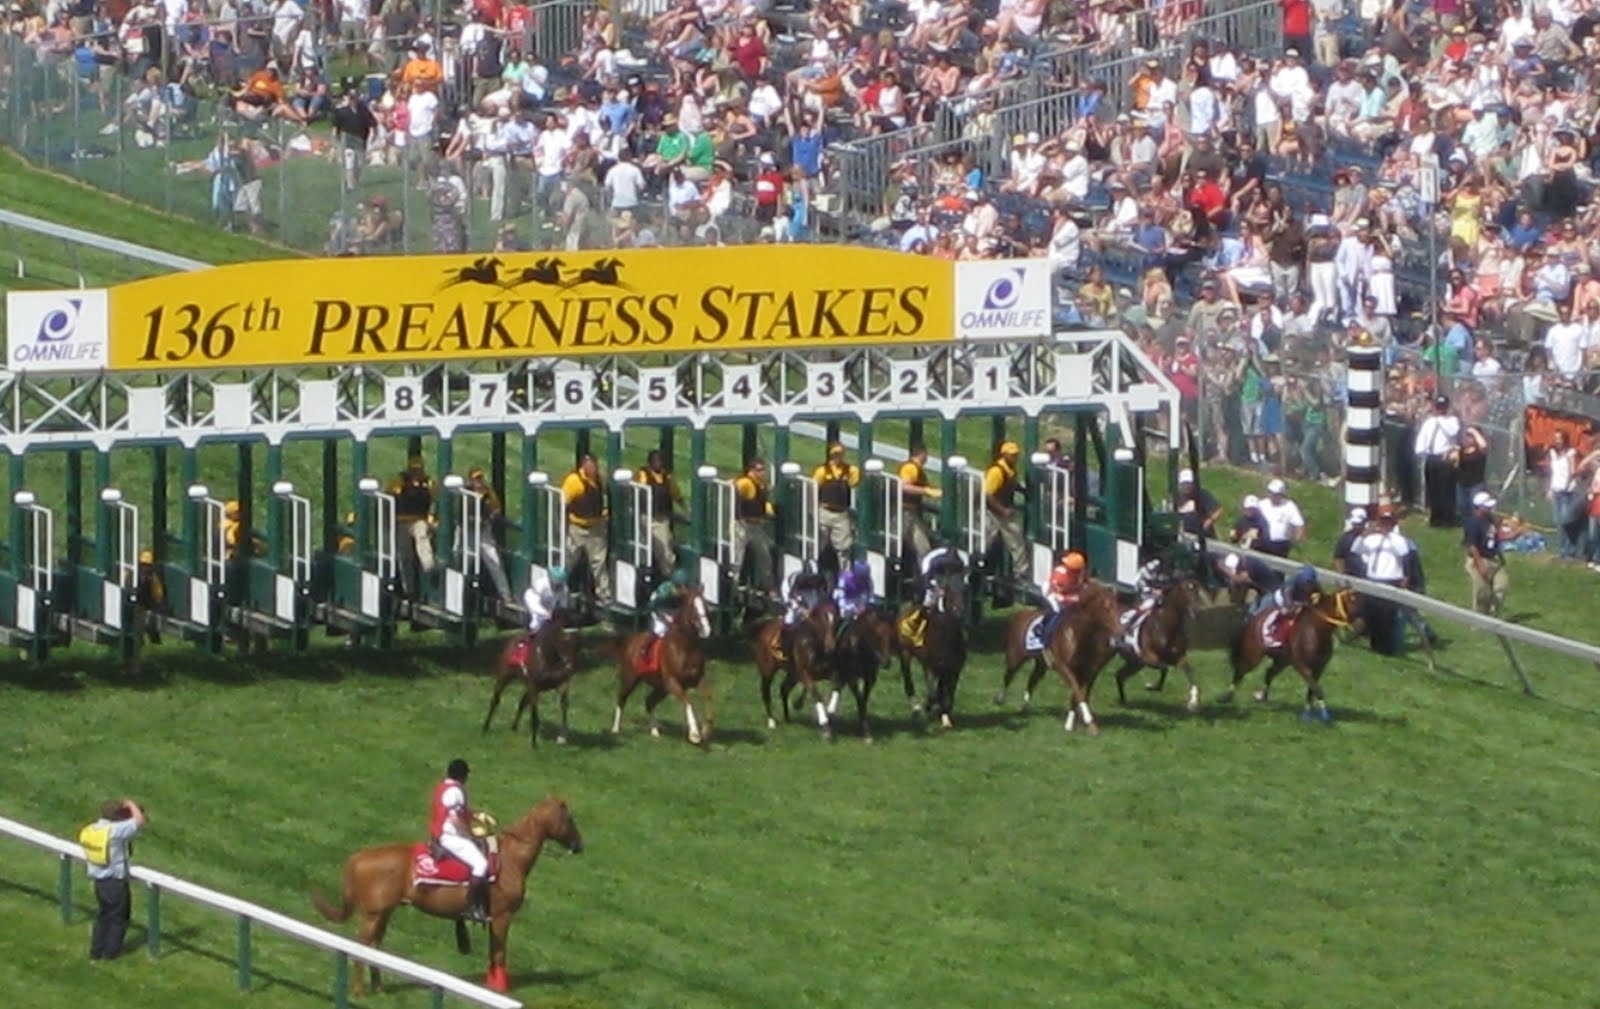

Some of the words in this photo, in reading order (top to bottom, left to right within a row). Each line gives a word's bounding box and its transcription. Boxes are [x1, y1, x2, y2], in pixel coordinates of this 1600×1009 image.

[137, 297, 282, 363] 136th
[304, 293, 680, 357] PREAKNESS
[692, 285, 930, 344] STAKES
[961, 309, 1047, 331] OMNILIFE
[13, 341, 102, 363] OMNILIFE
[648, 376, 667, 402] 5
[732, 374, 752, 399] 4
[816, 372, 836, 397] 3
[899, 369, 919, 394] 2
[984, 366, 999, 391] 1
[394, 386, 414, 411] 8
[479, 382, 498, 407] 7
[564, 379, 584, 405] 6
